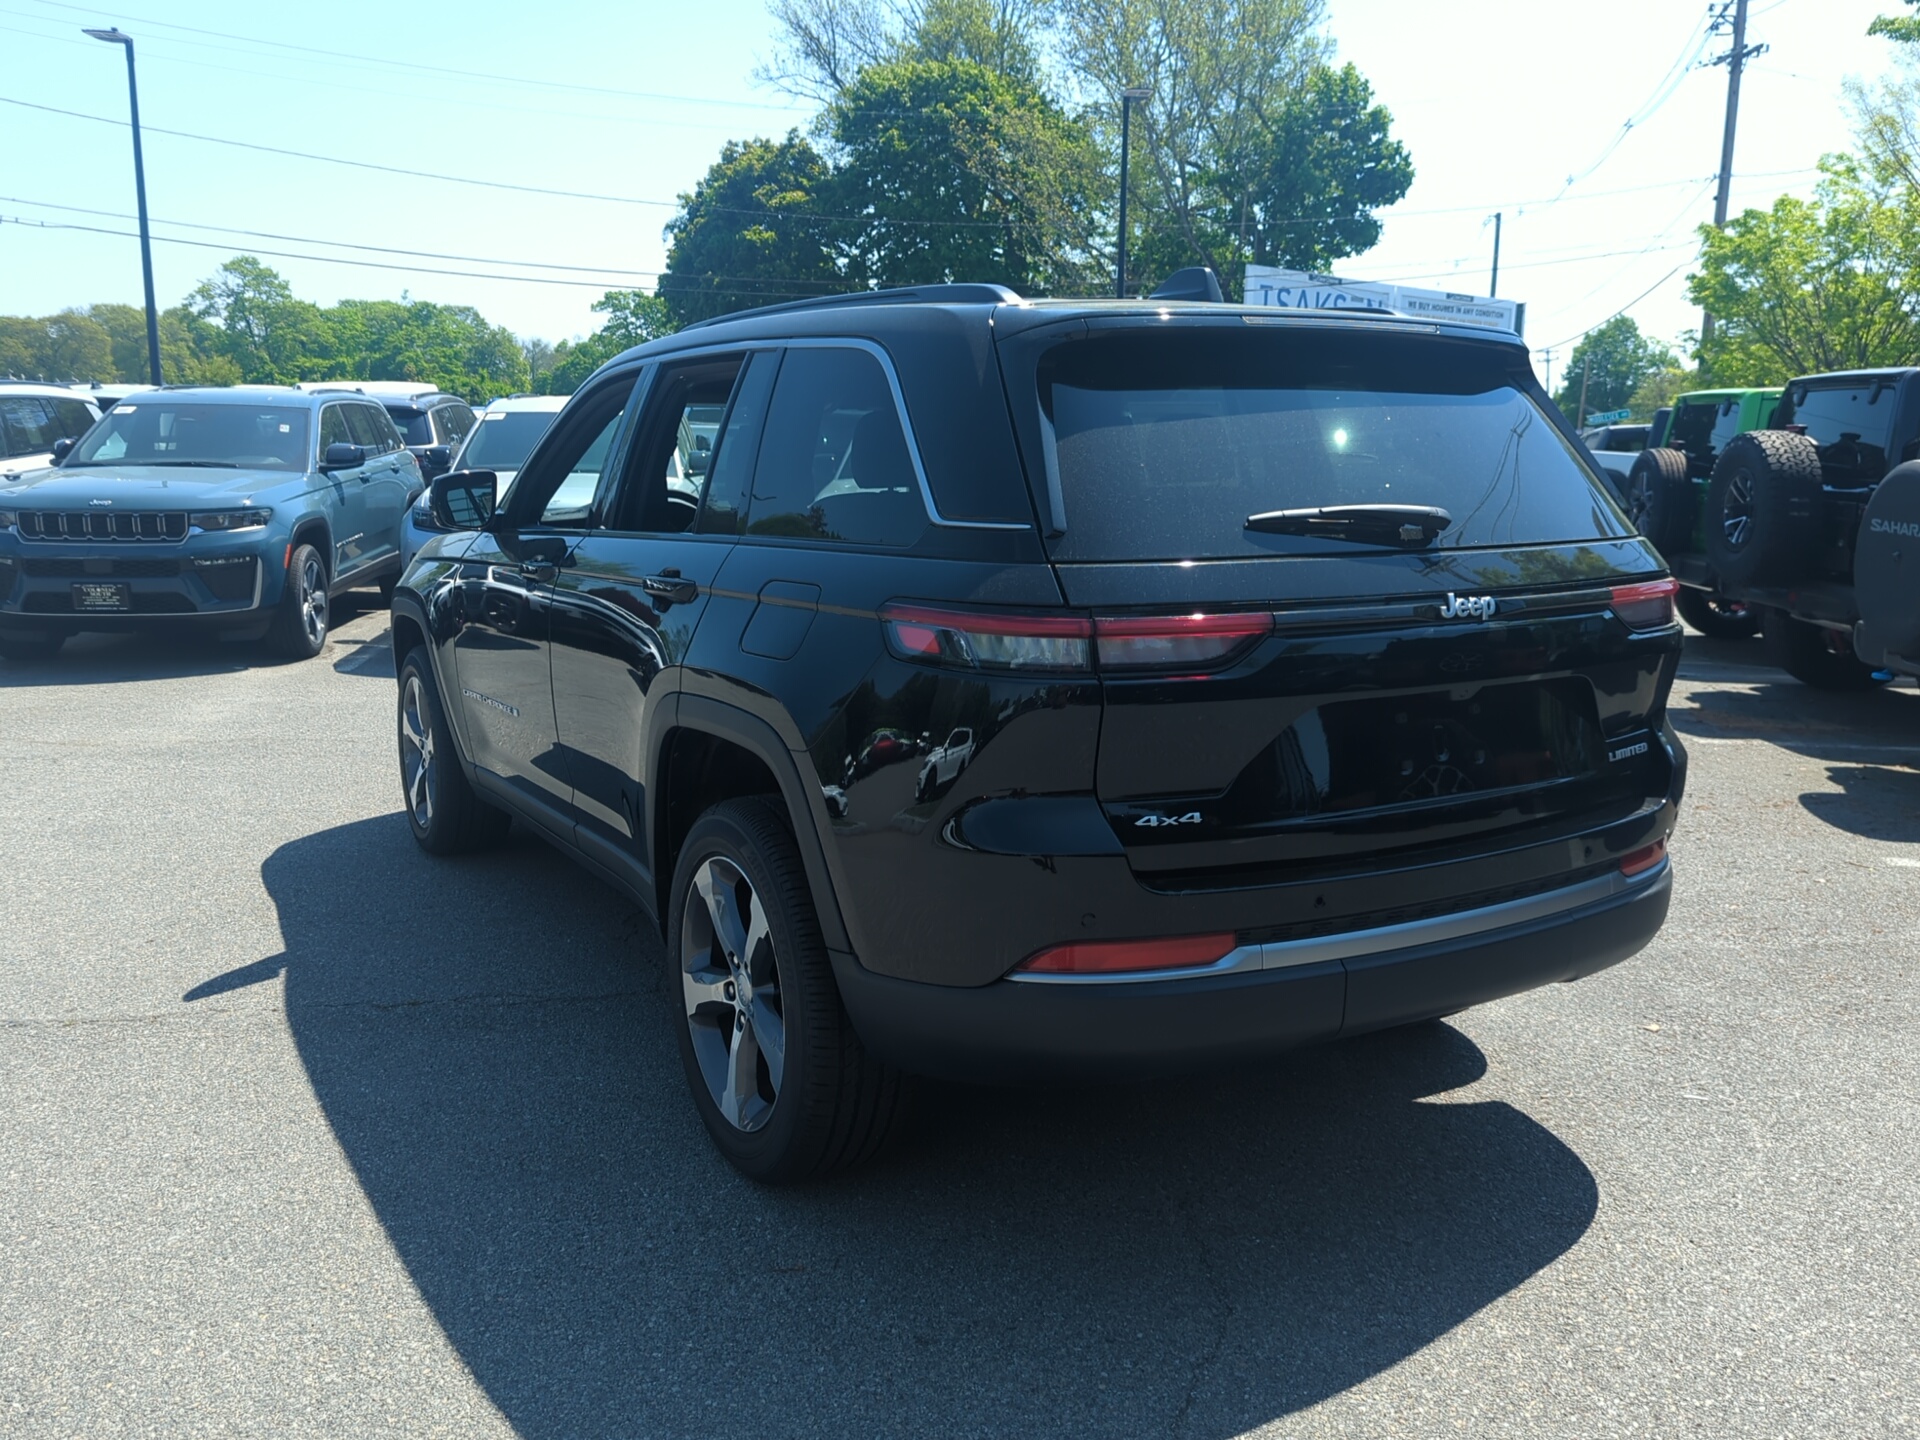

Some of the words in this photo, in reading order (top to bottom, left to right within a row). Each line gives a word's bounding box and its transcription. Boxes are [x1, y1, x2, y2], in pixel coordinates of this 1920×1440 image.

[1408, 301, 1417, 309] WE
[1418, 302, 1430, 311] BUY
[1431, 304, 1455, 313] HOUSES
[1463, 307, 1475, 316] ANY
[1475, 309, 1504, 319] CONDITION
[89, 499, 112, 507] Jeep
[1870, 518, 1920, 537] SAHAR
[1440, 592, 1496, 621] Jeep
[1608, 742, 1648, 762] LIMITED
[1134, 812, 1203, 827] 4x4
